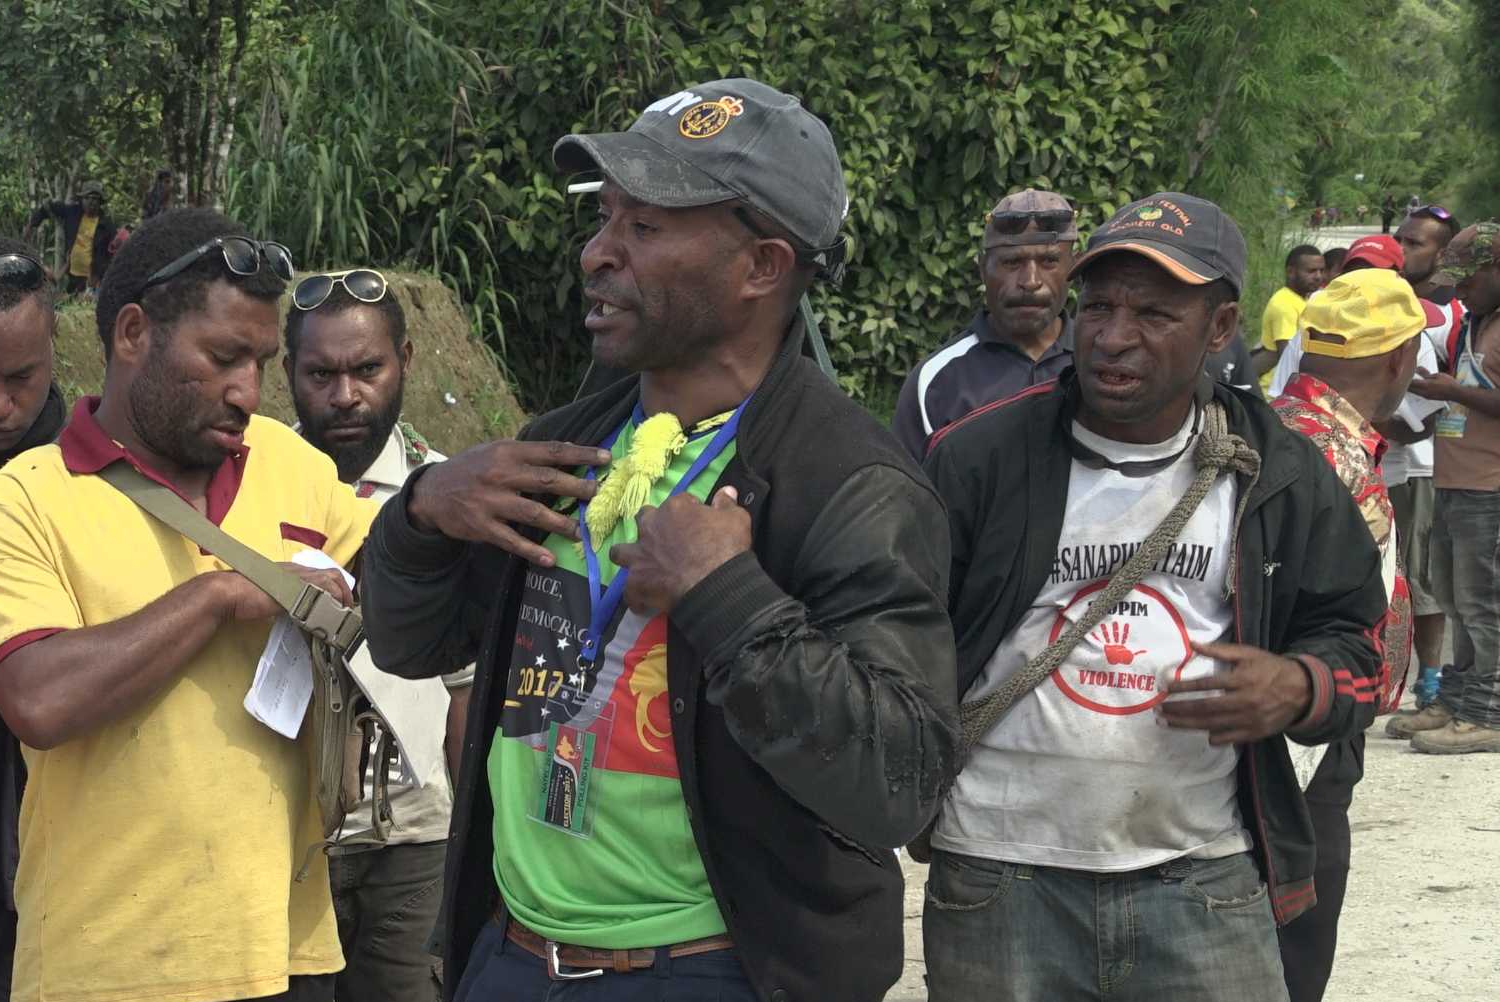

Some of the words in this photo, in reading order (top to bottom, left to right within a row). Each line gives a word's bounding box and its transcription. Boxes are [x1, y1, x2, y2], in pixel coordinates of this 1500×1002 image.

[521, 604, 589, 643] DEMOCRAC
[517, 667, 564, 698] 2017
[1078, 669, 1156, 692] VIOLENCE
